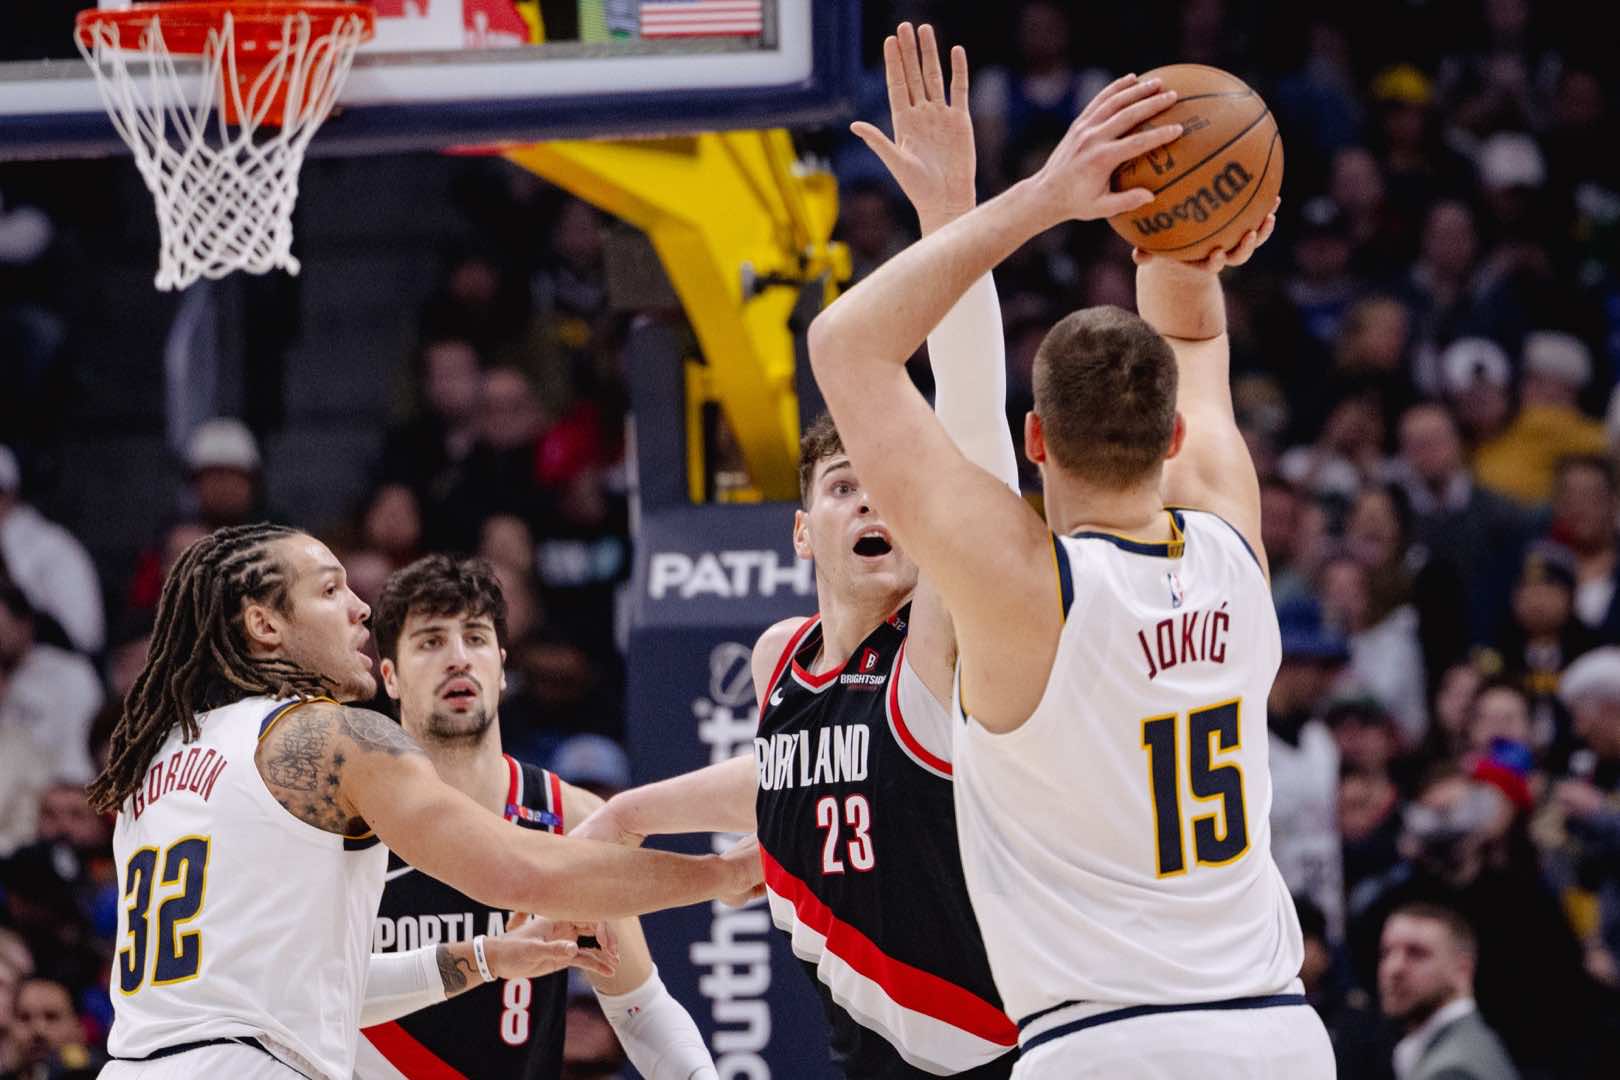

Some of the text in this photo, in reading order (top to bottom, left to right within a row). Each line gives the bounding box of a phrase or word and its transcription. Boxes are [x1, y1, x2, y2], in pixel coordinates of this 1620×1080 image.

[1132, 160, 1253, 236] Wilson
[649, 550, 811, 599] PATH
[1137, 601, 1230, 680] JOKIĆ
[132, 747, 228, 821] GORDON
[1140, 696, 1252, 880] 15
[815, 795, 876, 875] 23
[118, 834, 212, 996] 32
[372, 911, 513, 953] PORTLA
[501, 976, 532, 1046] 8
